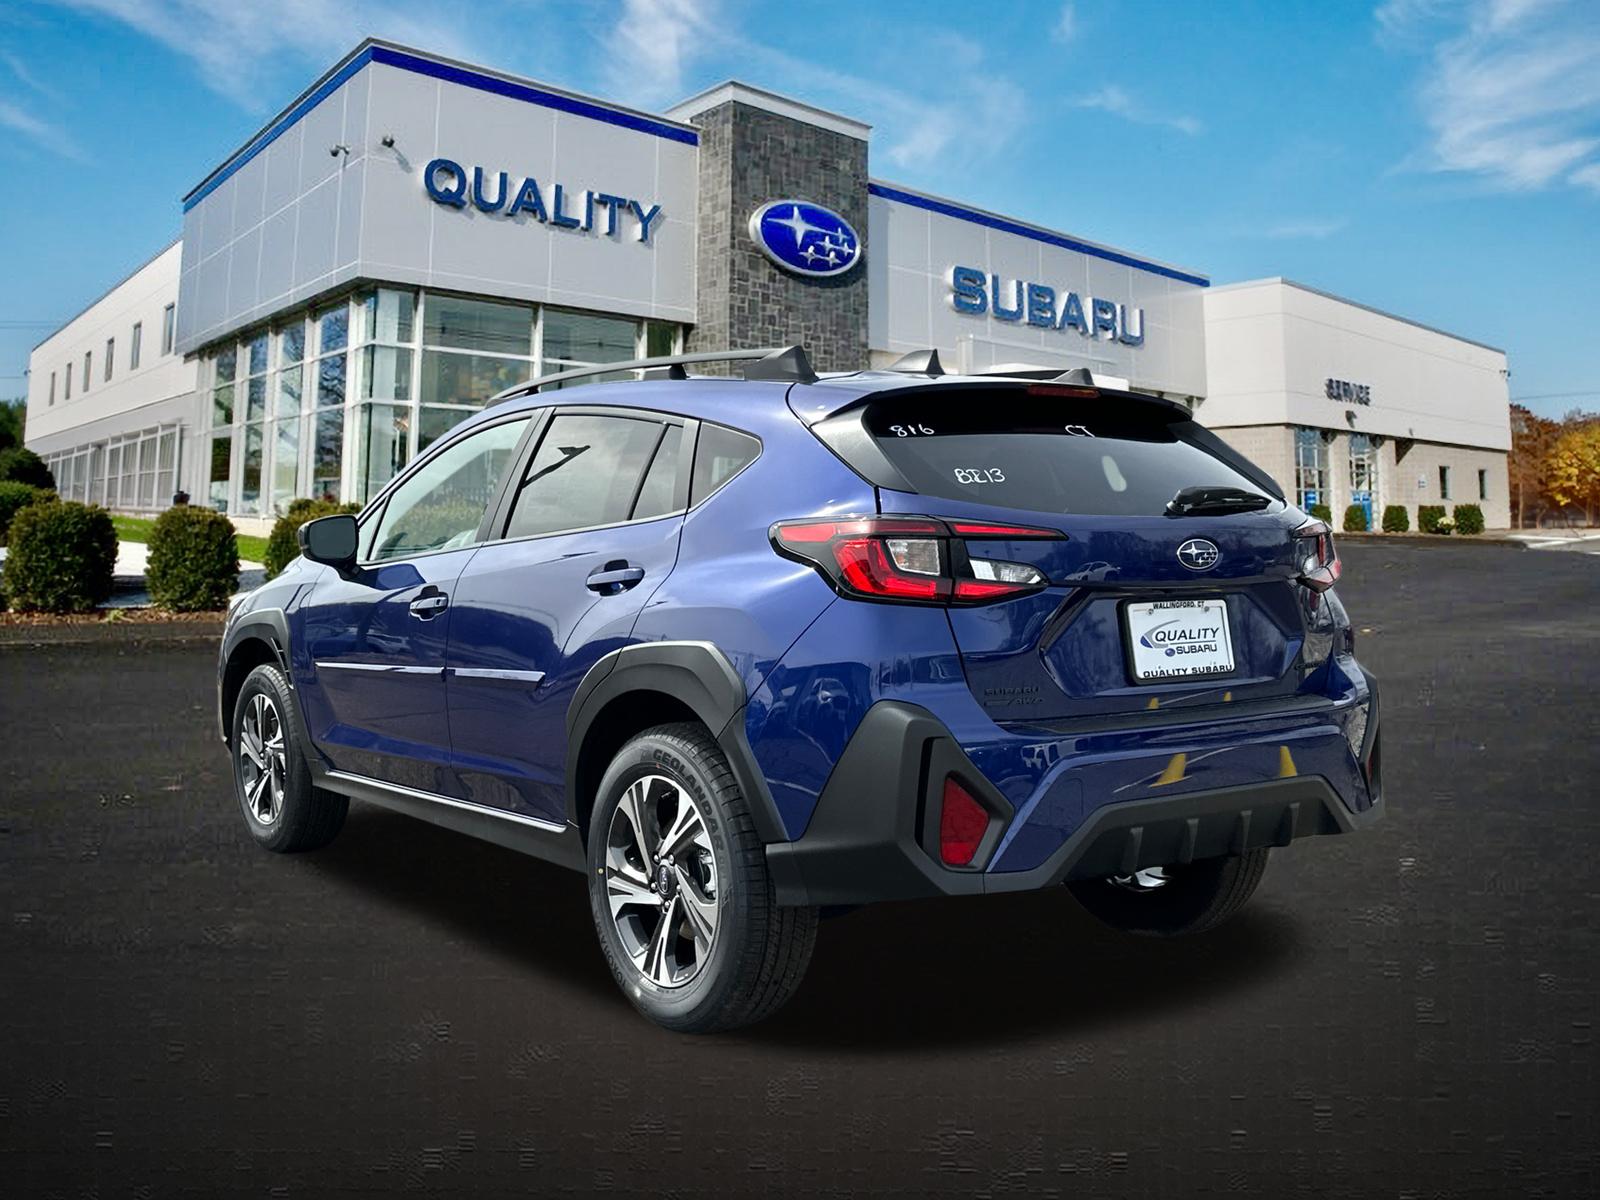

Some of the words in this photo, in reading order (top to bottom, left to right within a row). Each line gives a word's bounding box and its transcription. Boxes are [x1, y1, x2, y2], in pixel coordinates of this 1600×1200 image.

[424, 158, 661, 243] QUALITY
[951, 265, 1145, 346] SUBARU
[1155, 627, 1219, 642] QUALITY
[1176, 644, 1217, 655] SUBARU
[1143, 667, 1188, 678] QUALITY
[1191, 665, 1232, 674] SUBARU
